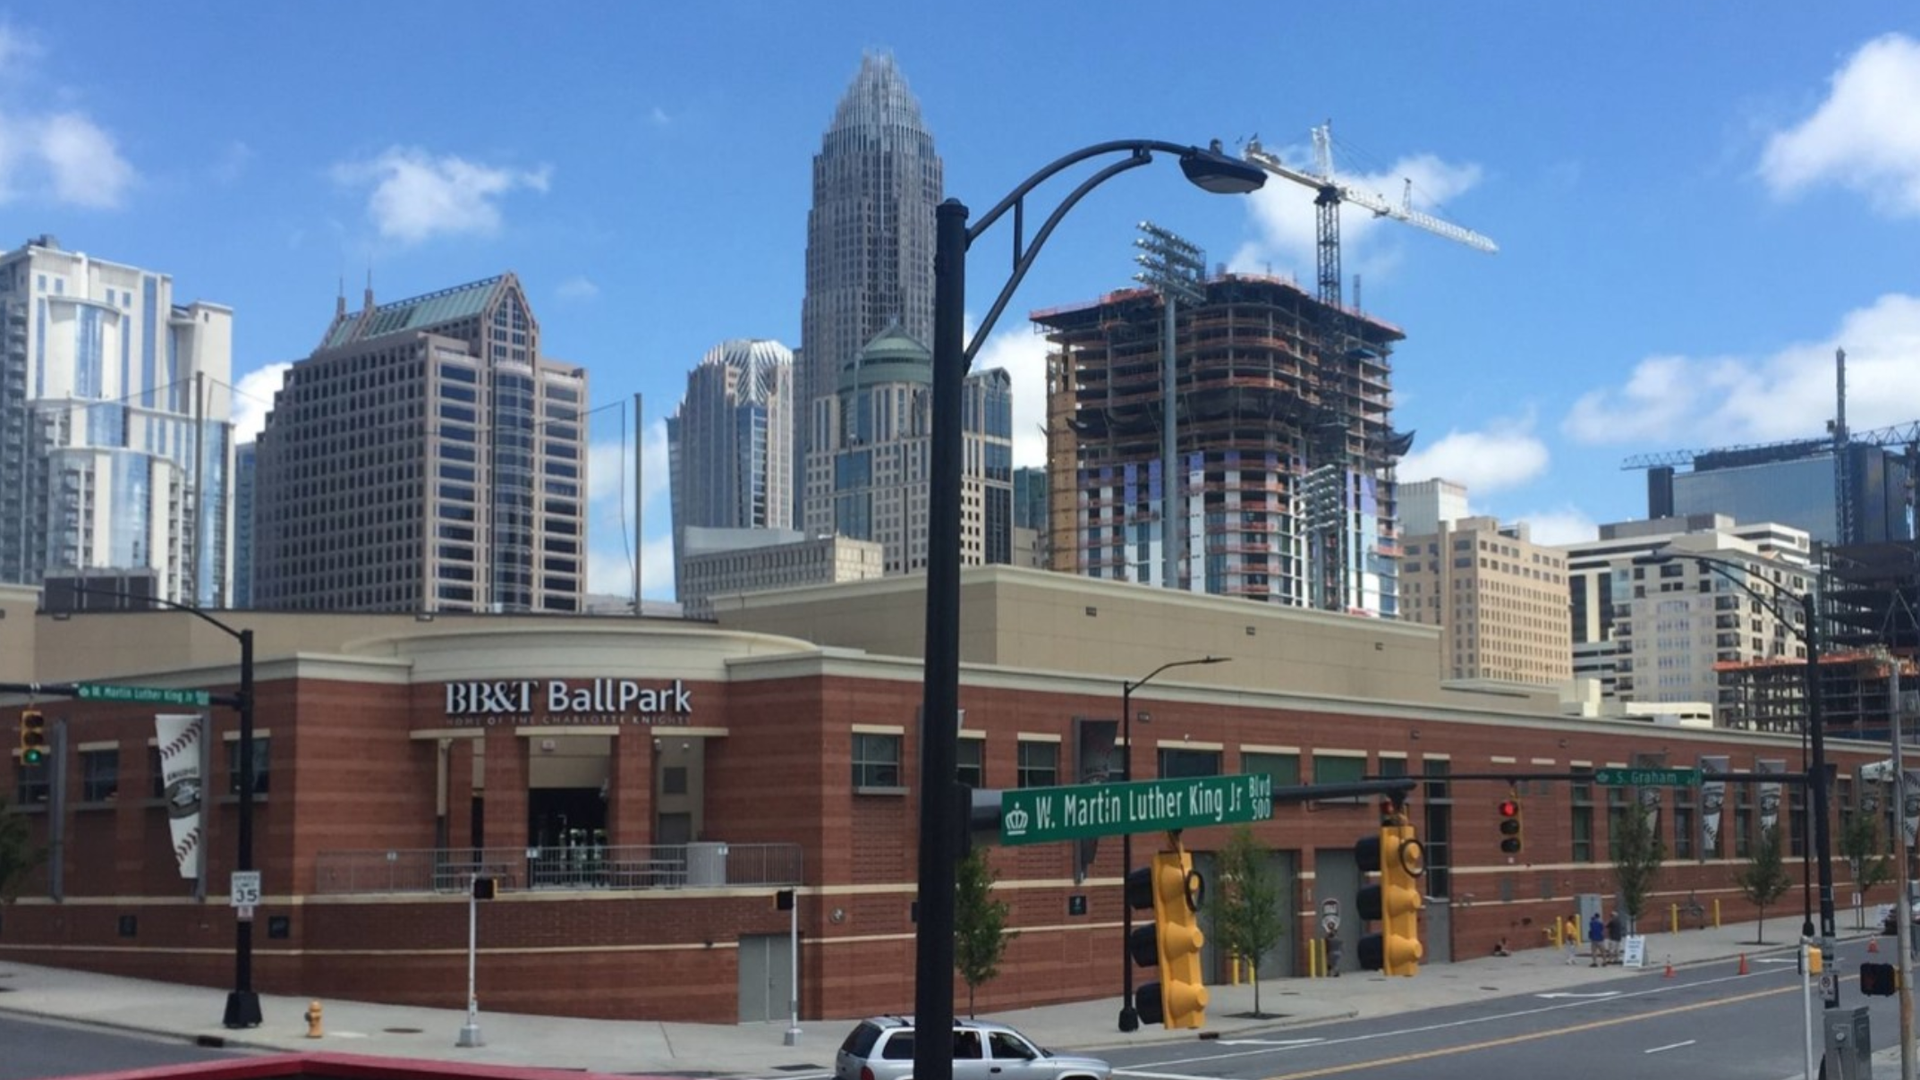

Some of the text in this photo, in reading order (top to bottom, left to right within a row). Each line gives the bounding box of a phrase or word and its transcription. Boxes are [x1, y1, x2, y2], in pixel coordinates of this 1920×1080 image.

[445, 678, 692, 713] BB&T BallPark
[487, 716, 503, 725] OF
[511, 715, 535, 725] THE
[543, 714, 625, 725] CHARLOTTE
[1249, 774, 1271, 798] Blvd
[1631, 771, 1677, 784] Graham
[1036, 782, 1243, 830] W. Martin Luther King Jr
[1251, 798, 1271, 820] 500
[236, 889, 257, 903] 35
